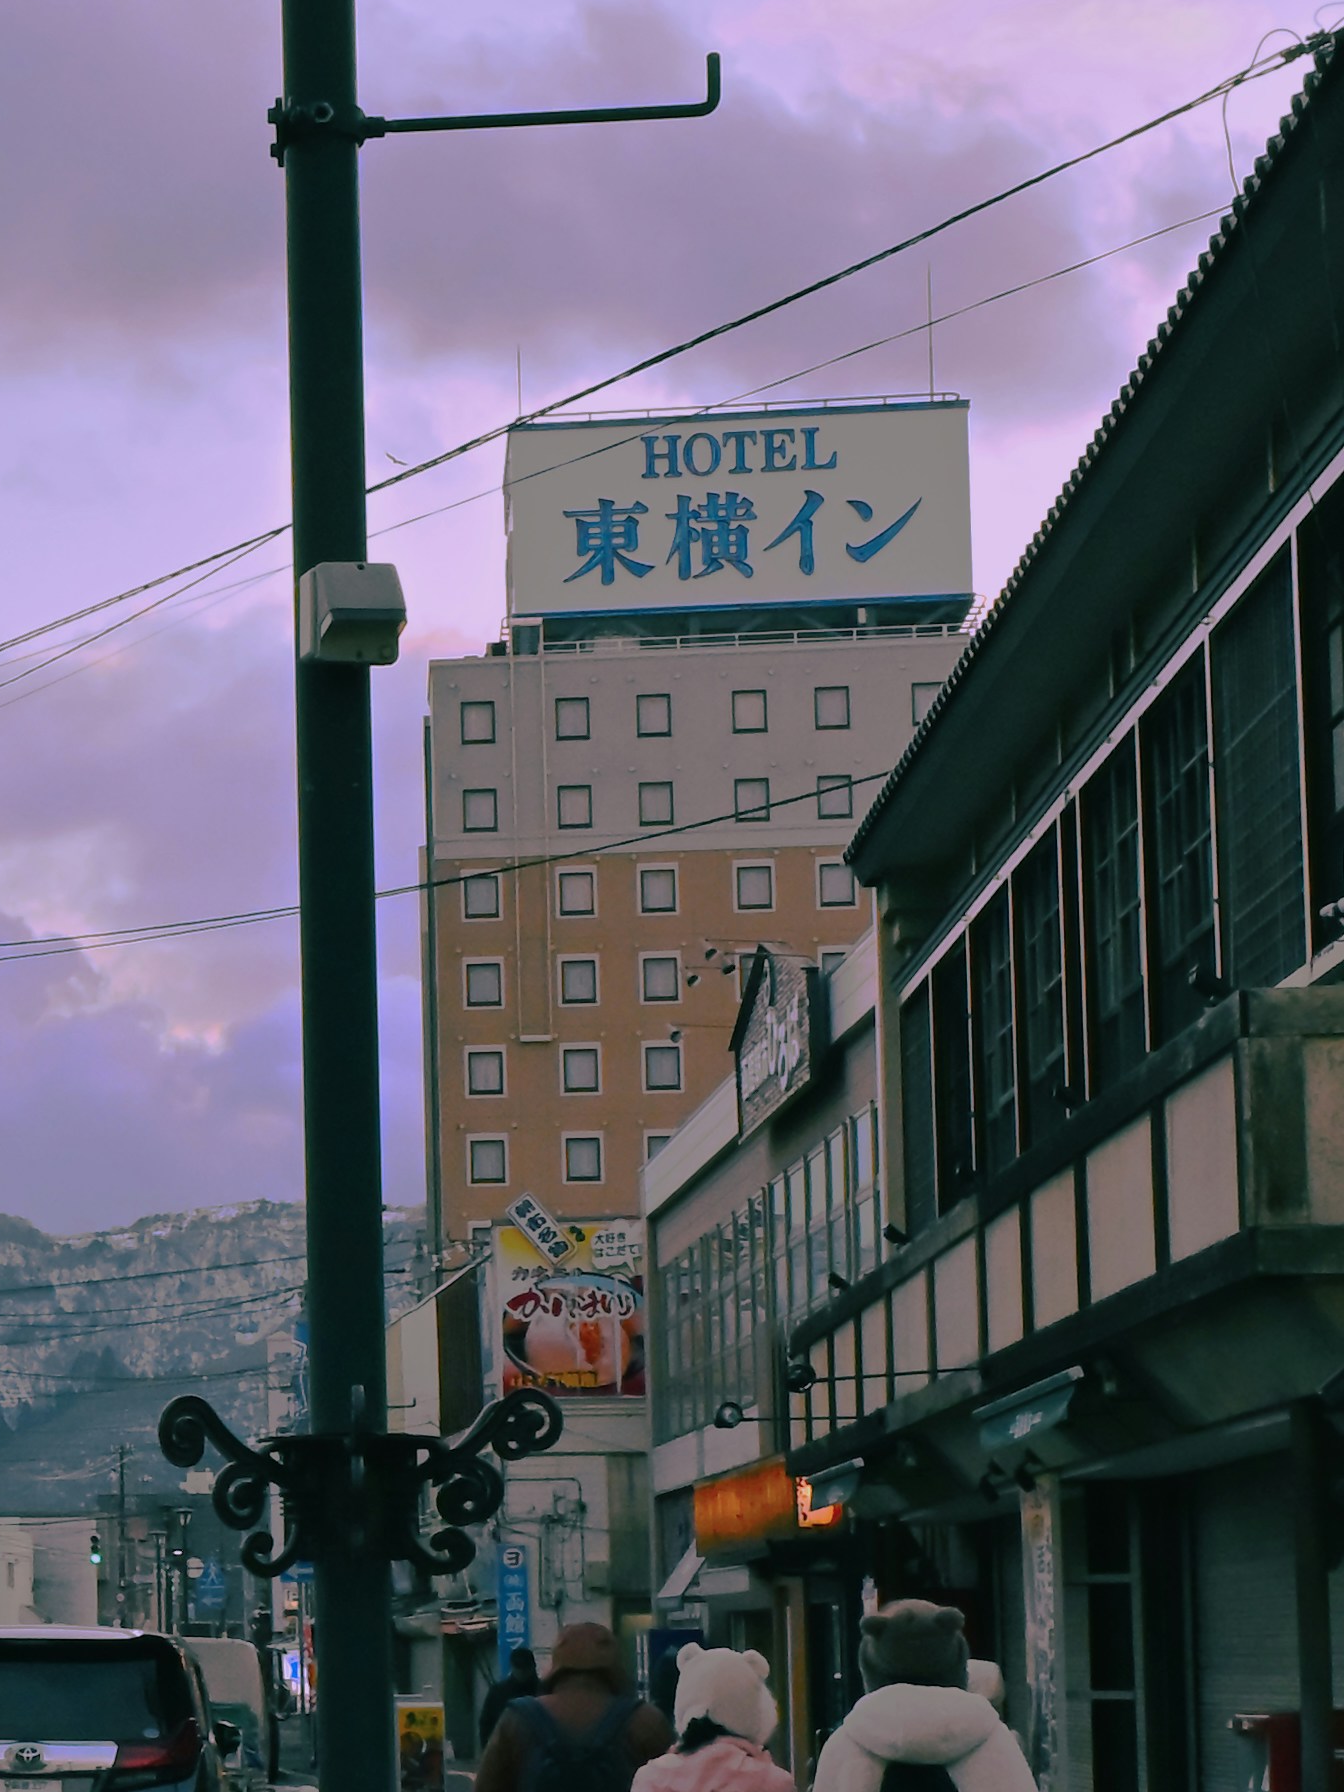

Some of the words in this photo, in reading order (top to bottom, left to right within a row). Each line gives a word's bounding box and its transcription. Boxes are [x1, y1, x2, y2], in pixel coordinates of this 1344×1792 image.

[641, 426, 838, 479] HOTEL
[562, 489, 923, 586] 東横イン
